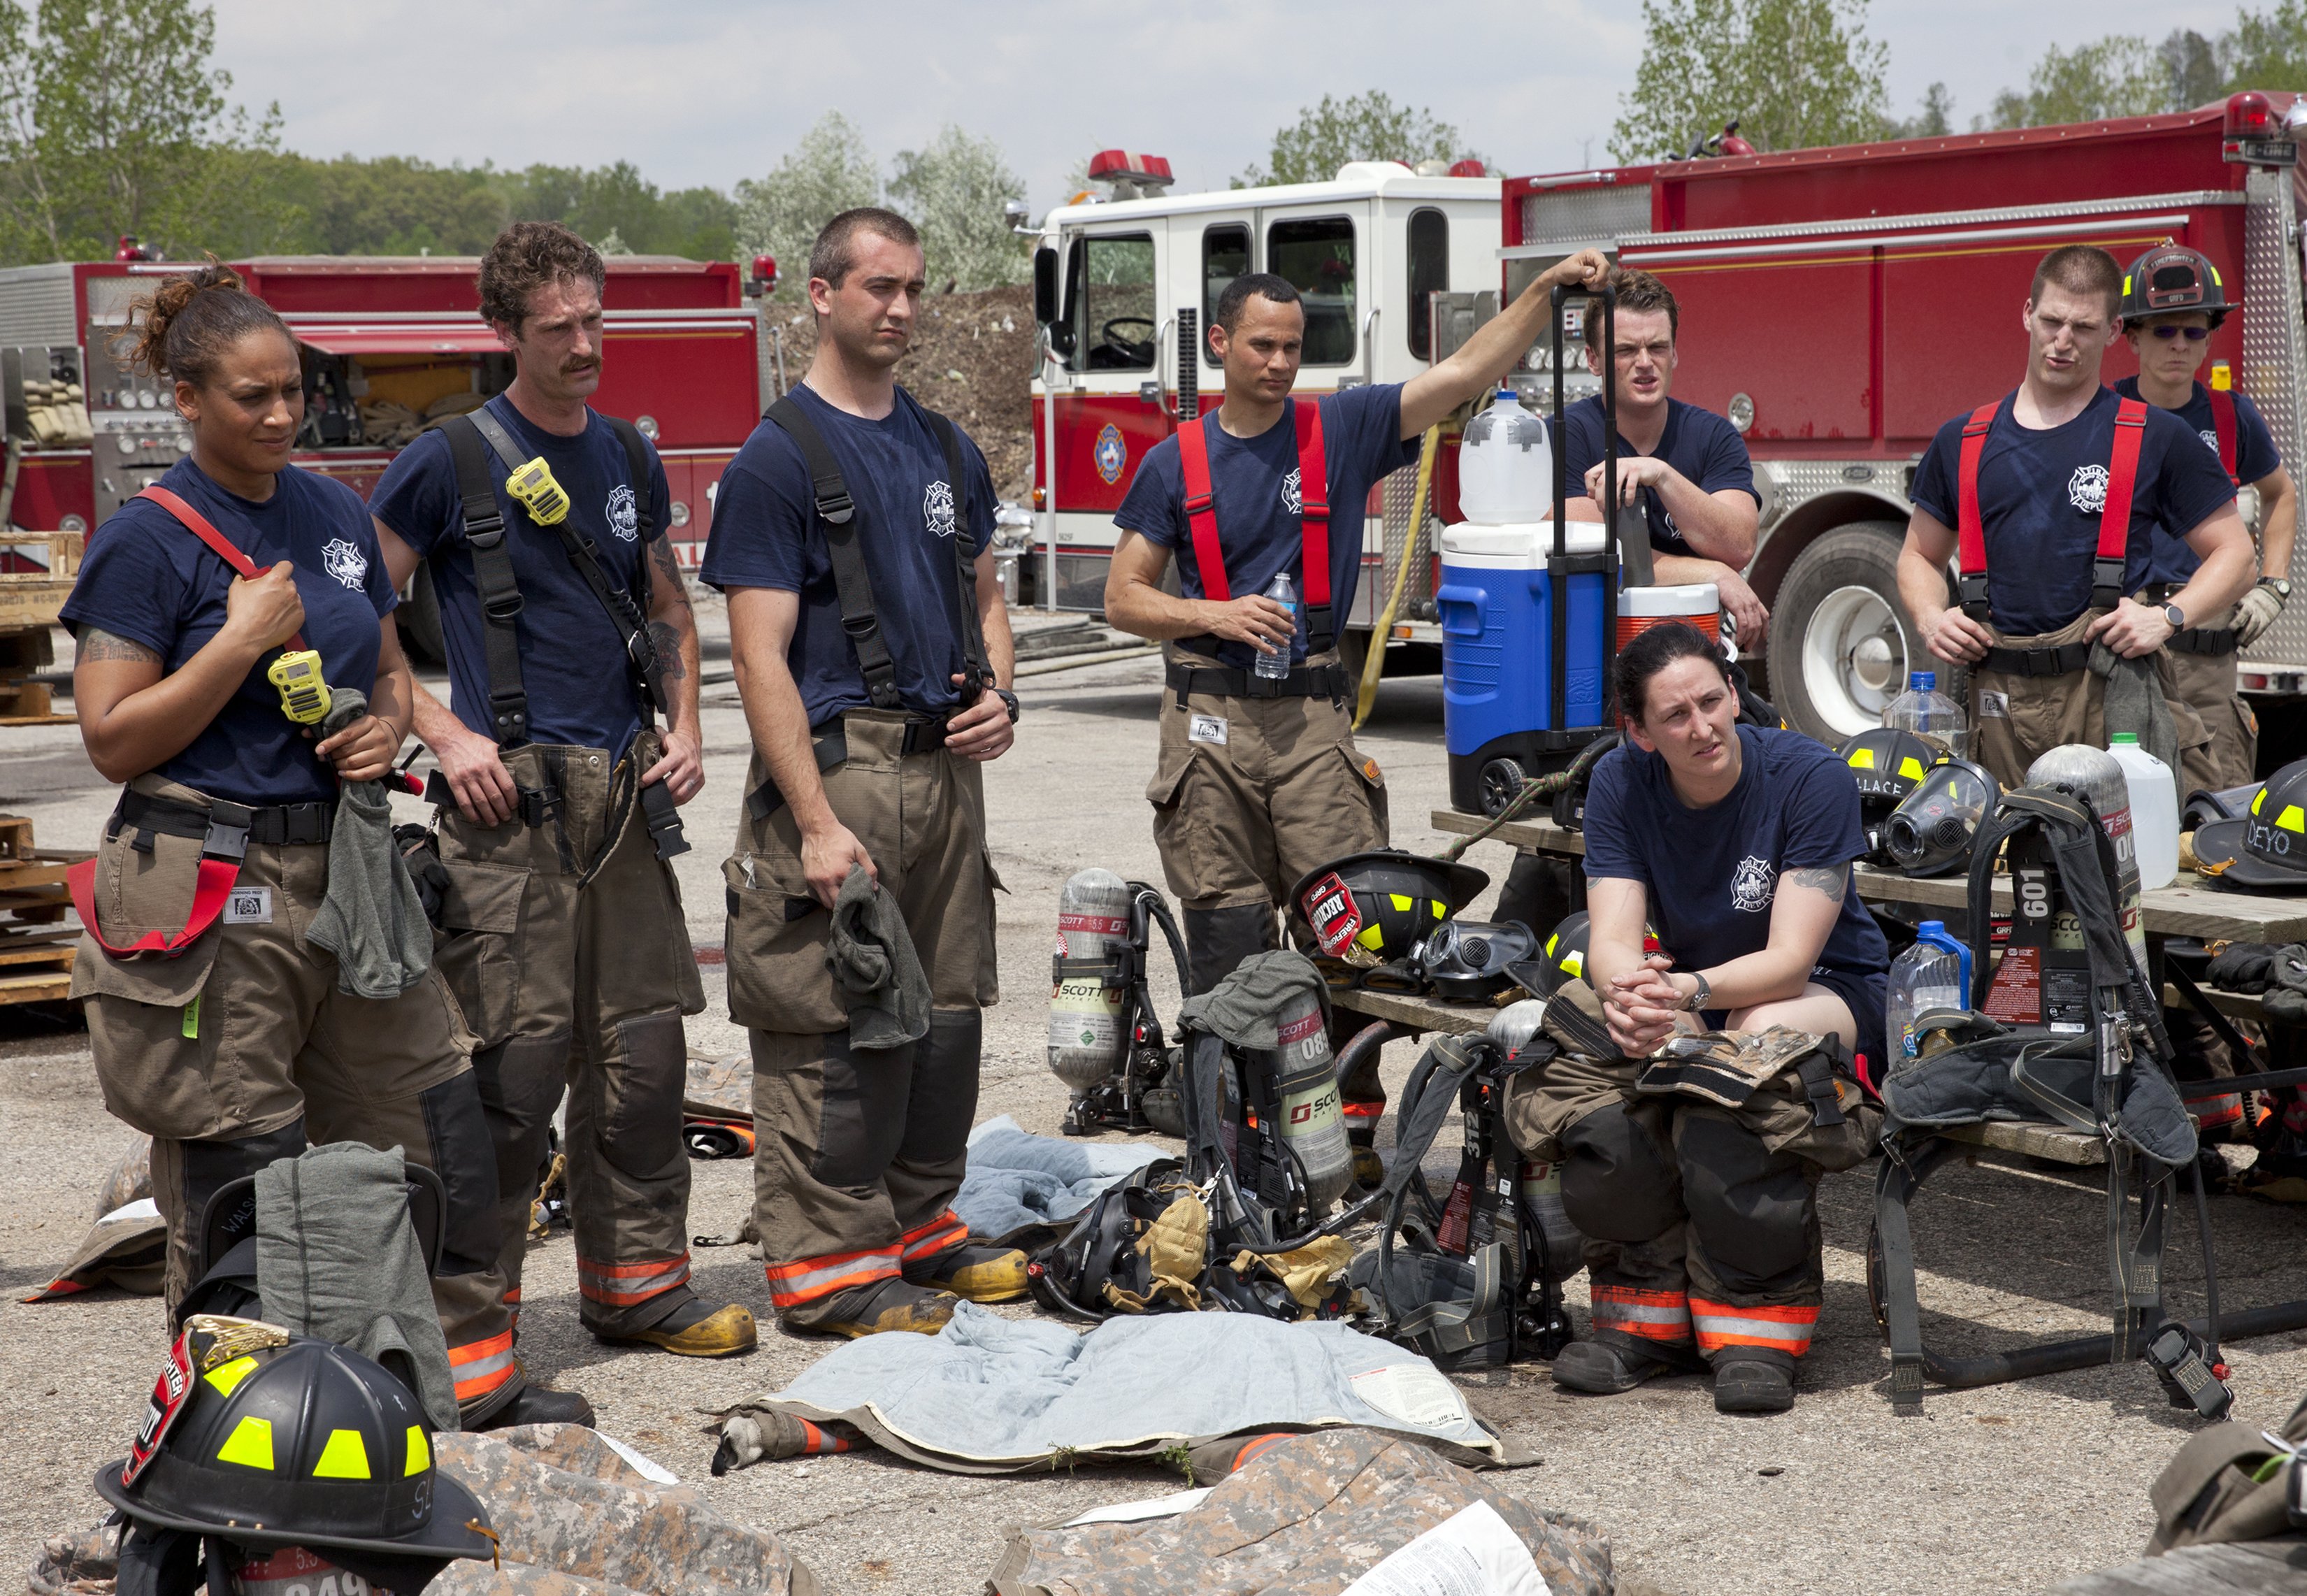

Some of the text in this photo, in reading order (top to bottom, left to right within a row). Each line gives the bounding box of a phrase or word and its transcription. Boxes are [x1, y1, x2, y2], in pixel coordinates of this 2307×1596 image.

[2150, 254, 2194, 268] FIREFIGHTER
[1856, 777, 1902, 794] LLACE
[2248, 819, 2290, 856] DEYO
[1311, 886, 1326, 901] GRFD
[2020, 870, 2049, 917] 601
[1744, 899, 1767, 909] DEPT
[1060, 916, 1084, 925] SCOTT
[1062, 985, 1104, 998] SCOTT
[1467, 1110, 1481, 1158] 312
